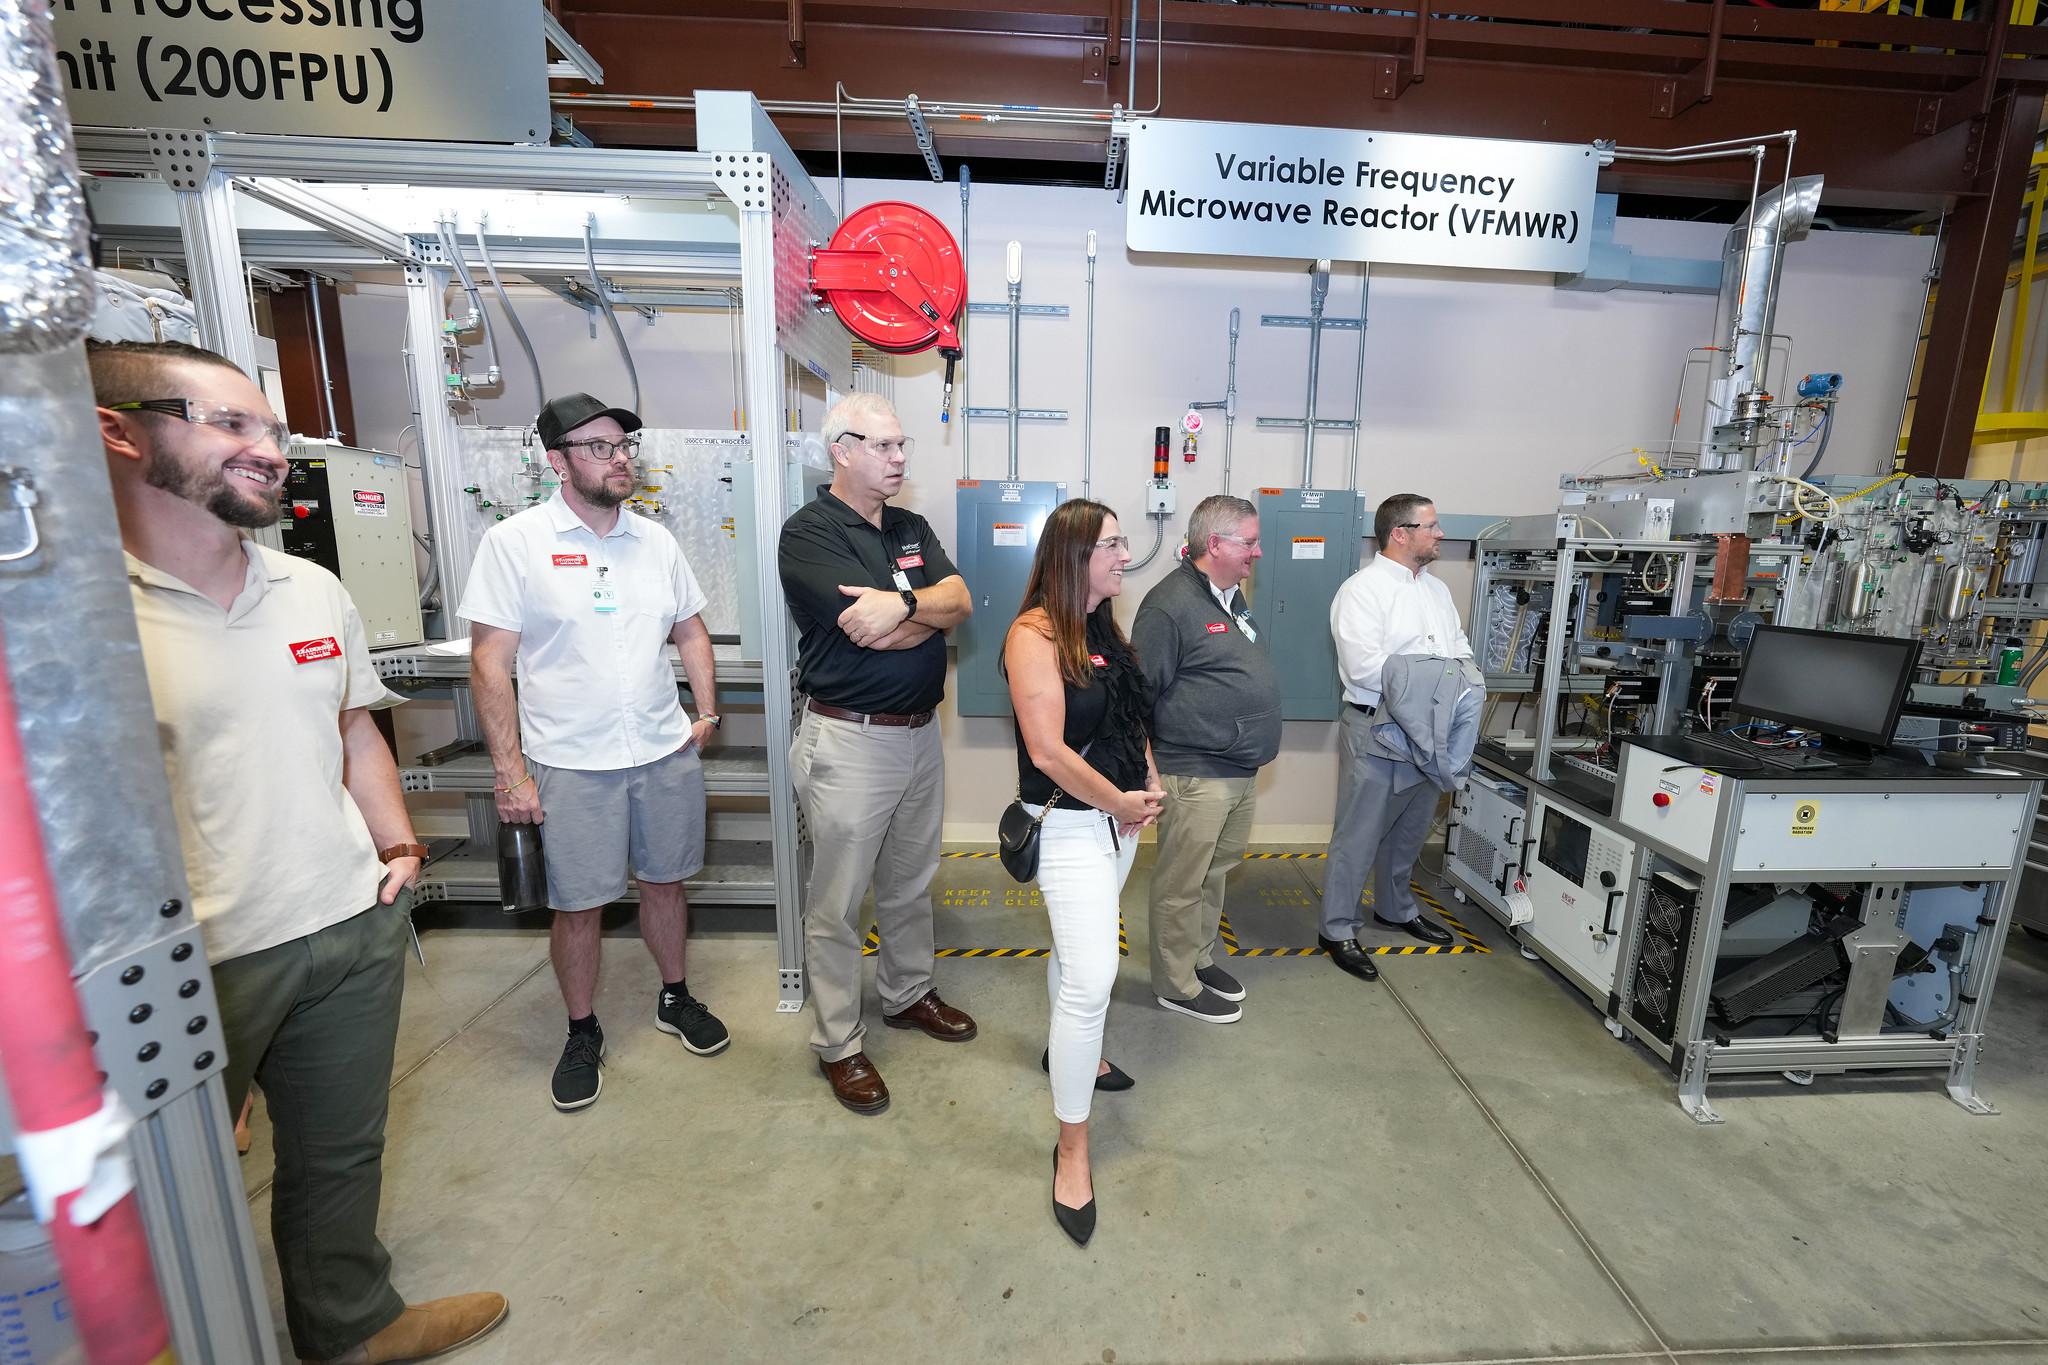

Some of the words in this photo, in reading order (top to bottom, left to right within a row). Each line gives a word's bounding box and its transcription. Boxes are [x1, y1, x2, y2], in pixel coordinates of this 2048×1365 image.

[57, 38, 117, 92] nit
[137, 36, 394, 113] (200FPU)
[1215, 152, 1345, 186] Variable
[1356, 161, 1515, 203] Frequency
[1139, 189, 1312, 224] Microwave
[1323, 199, 1440, 231] Reactor
[1448, 203, 1579, 244] (VFMWR)
[357, 492, 383, 502] DANGER
[945, 889, 991, 897] KEEP
[1006, 889, 1040, 897] FLO
